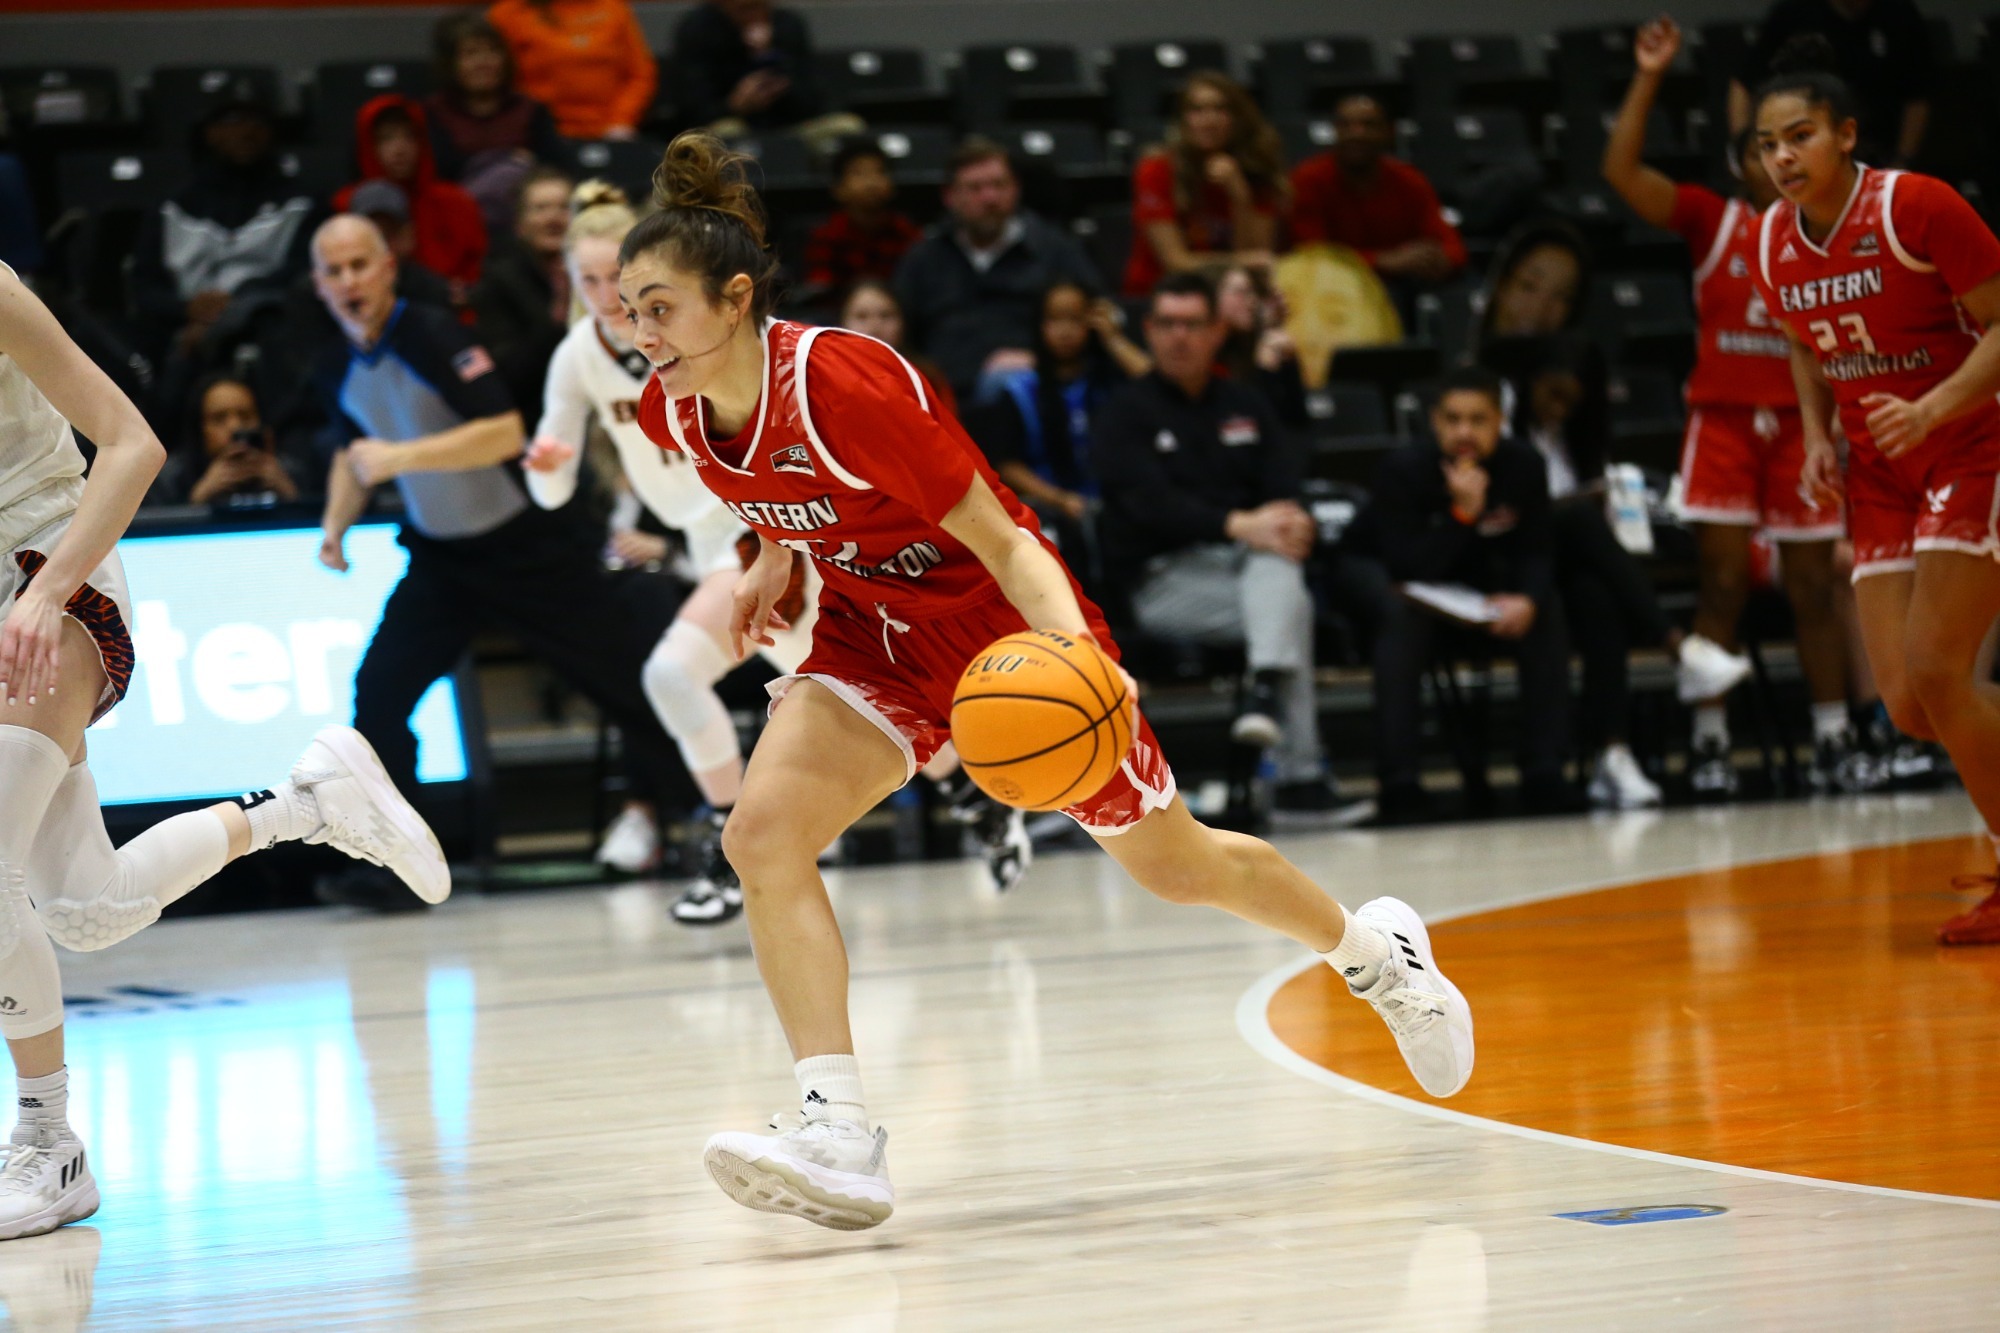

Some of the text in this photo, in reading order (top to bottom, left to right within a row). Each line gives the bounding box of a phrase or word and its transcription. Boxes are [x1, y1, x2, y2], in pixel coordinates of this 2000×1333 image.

[1779, 265, 1883, 313] EASTERN
[95, 600, 364, 728] ter
[967, 654, 1025, 677] EVO
